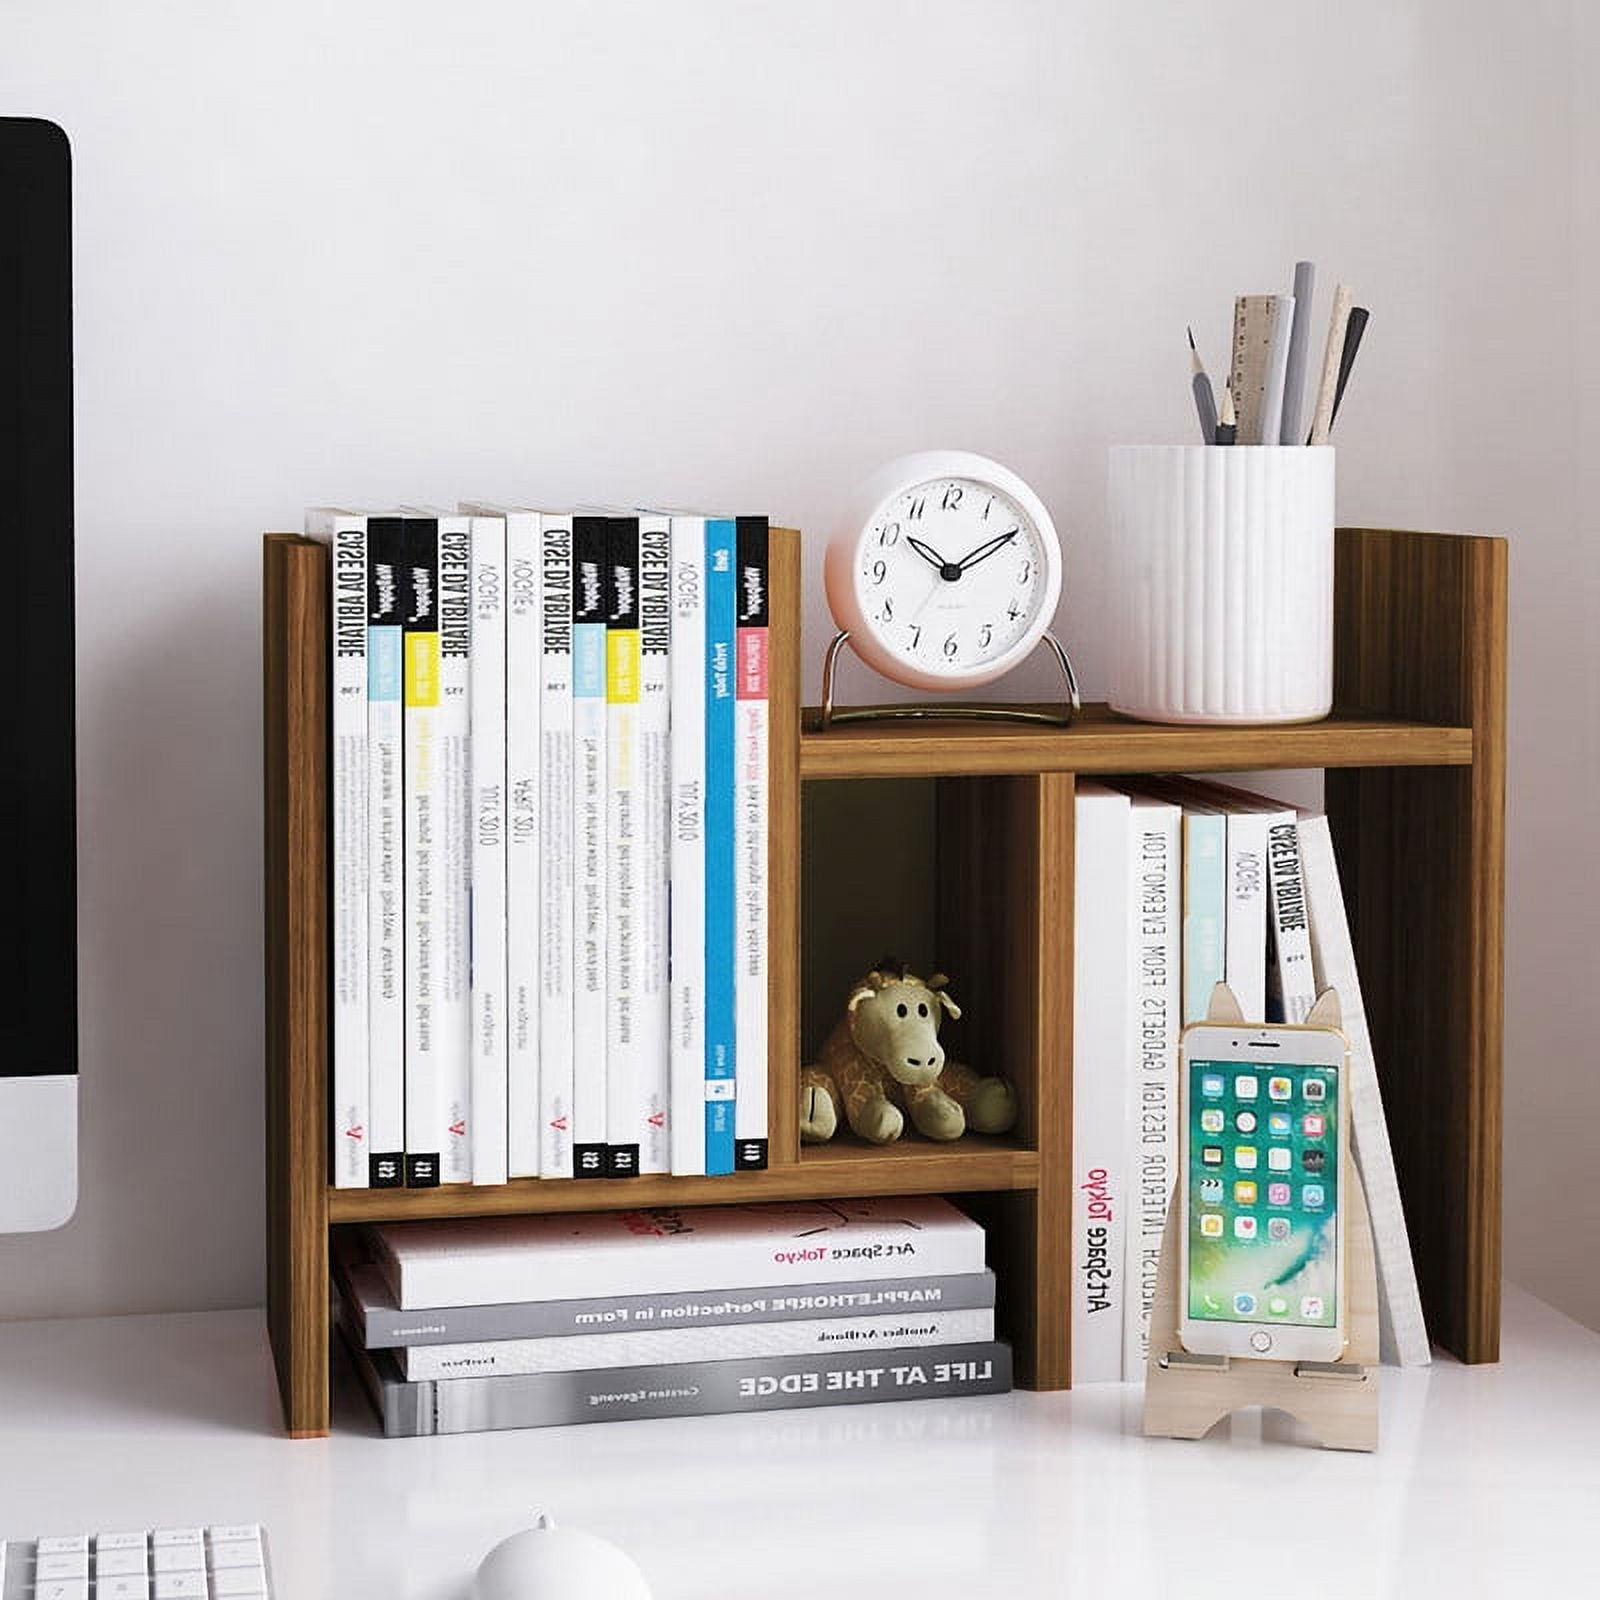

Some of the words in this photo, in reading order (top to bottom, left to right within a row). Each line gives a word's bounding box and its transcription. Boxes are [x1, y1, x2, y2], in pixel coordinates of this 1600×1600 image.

[910, 497, 925, 520] 11
[942, 488, 963, 510] 12
[984, 499, 993, 520] 1
[880, 522, 900, 546] 10
[873, 560, 886, 584] 9
[1018, 560, 1030, 584] 3
[882, 597, 894, 622] 8
[1007, 597, 1021, 621] 4
[908, 624, 921, 649] 7
[944, 632, 958, 656] 6
[979, 624, 993, 648] 5
